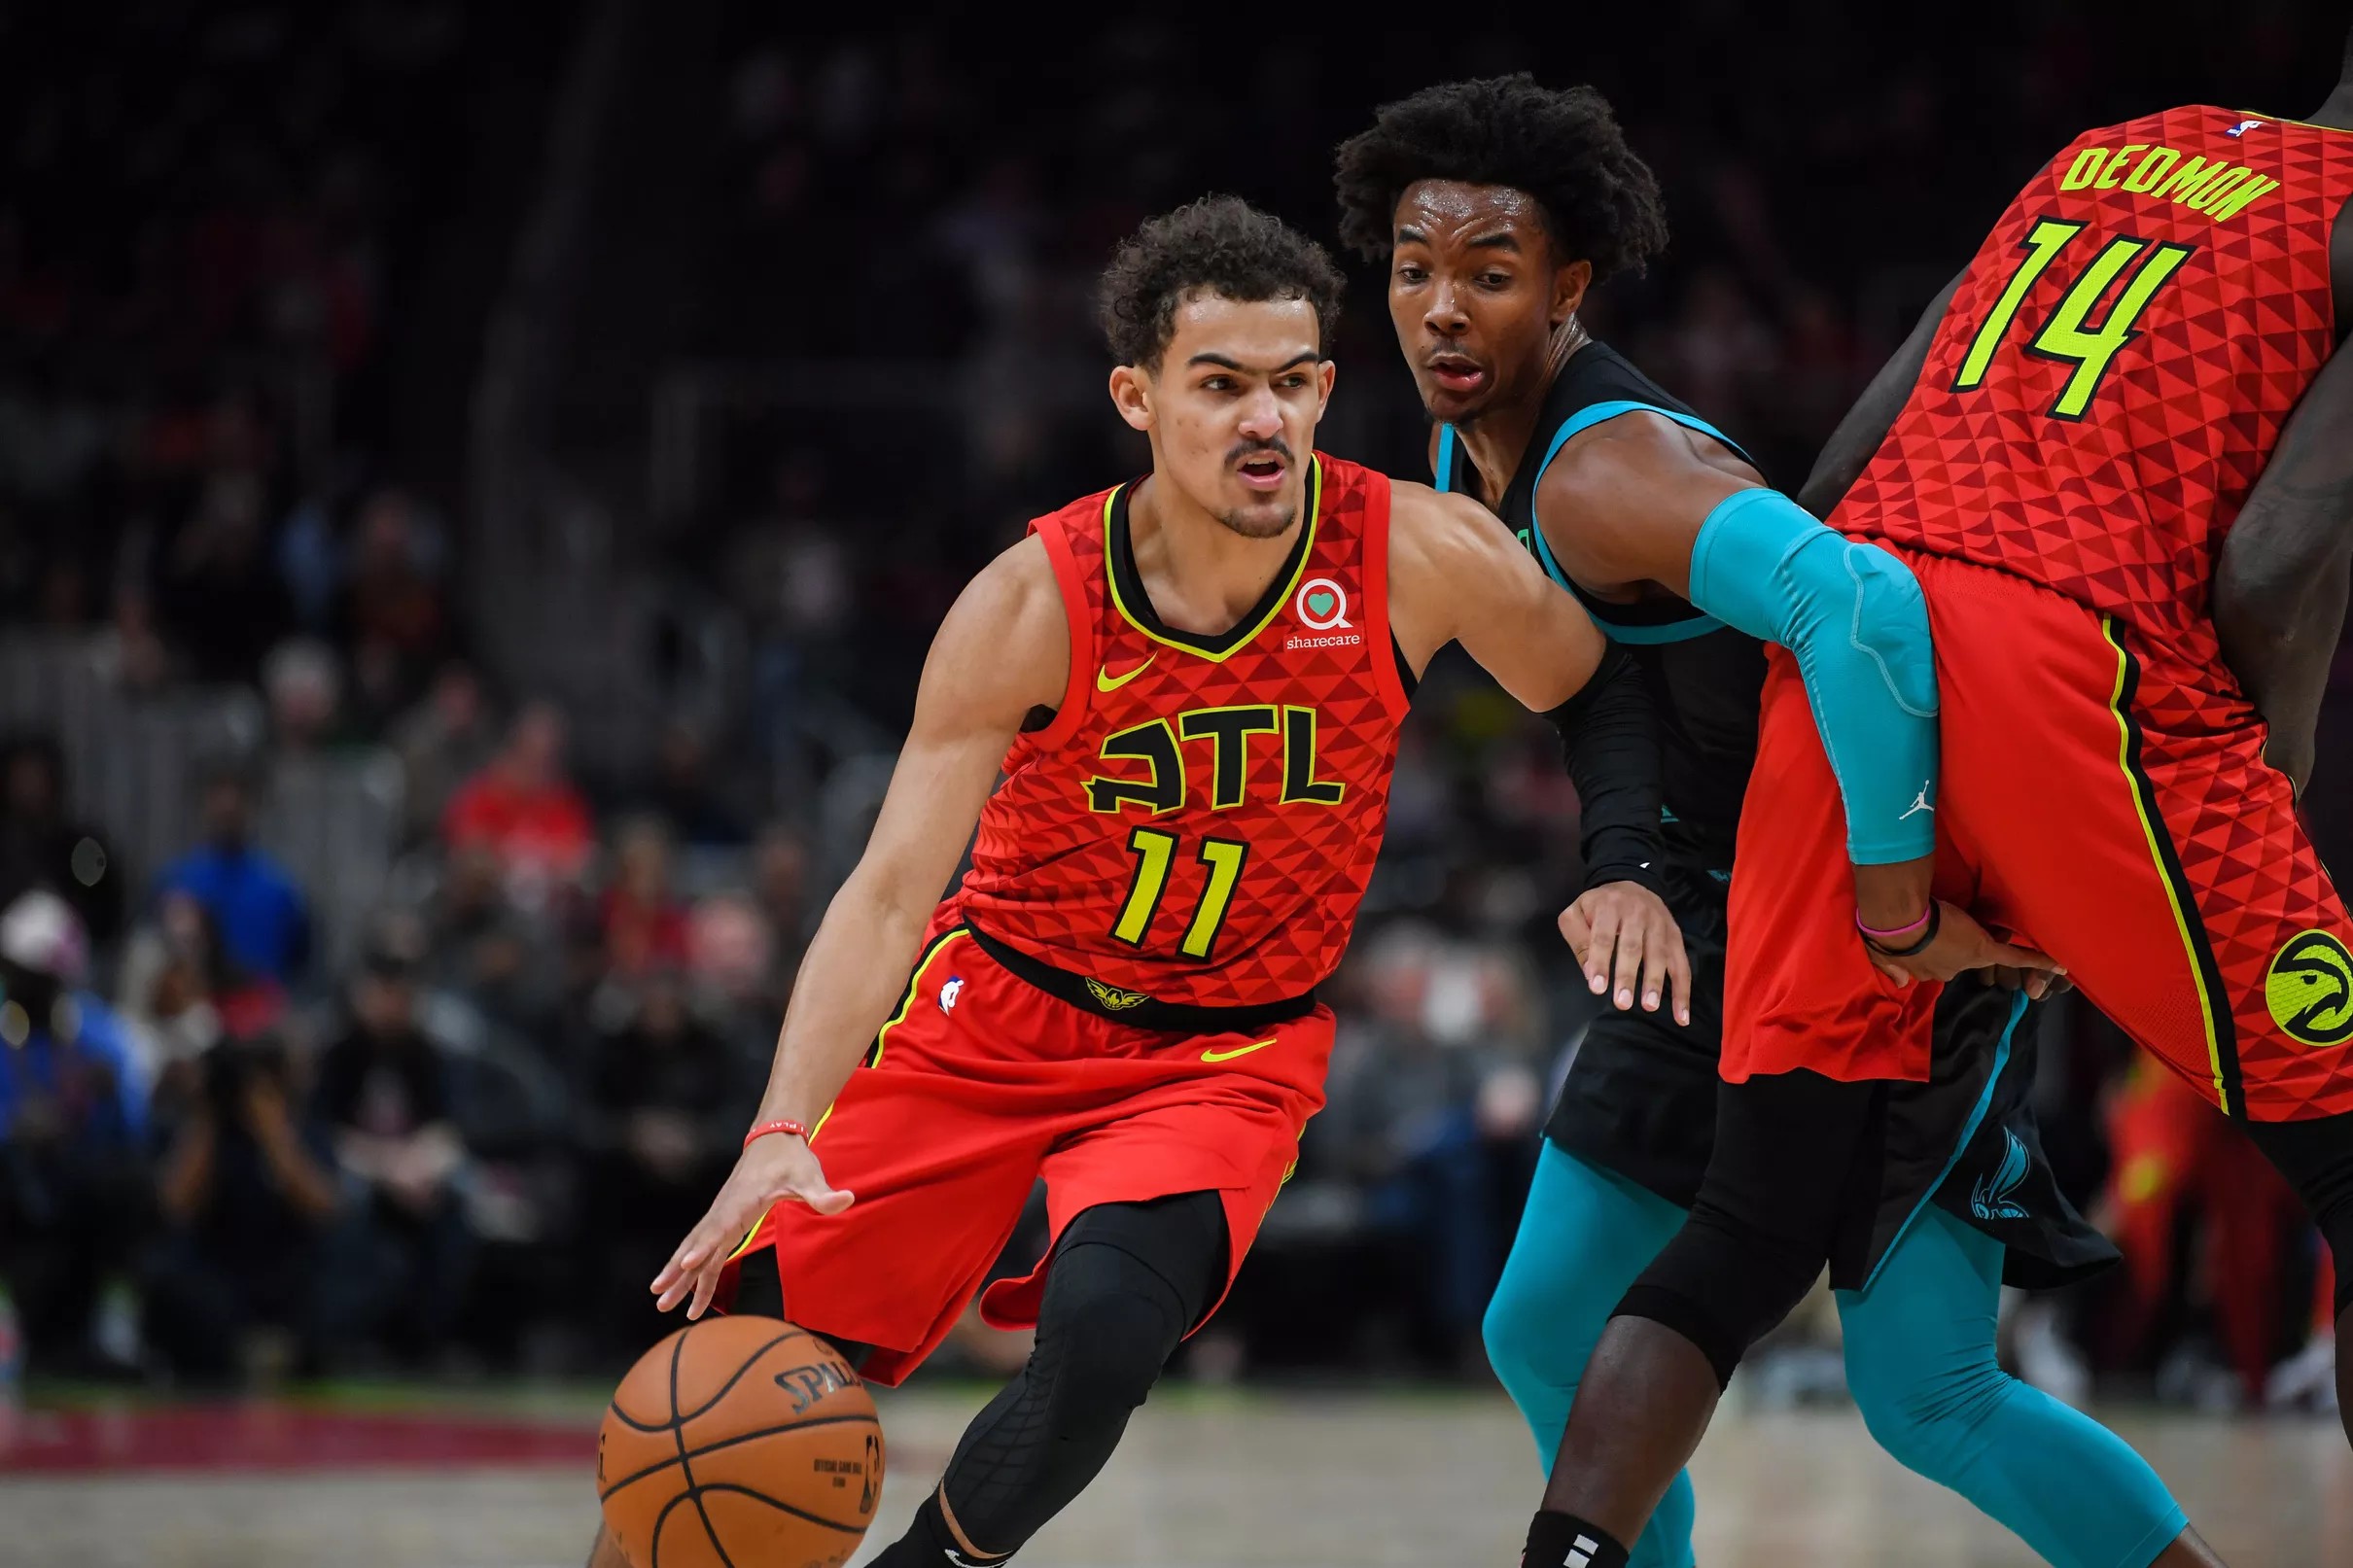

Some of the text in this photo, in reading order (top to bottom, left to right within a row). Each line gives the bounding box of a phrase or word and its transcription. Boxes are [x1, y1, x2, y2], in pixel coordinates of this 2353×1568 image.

[2060, 145, 2280, 222] DEDMON
[1949, 215, 2197, 423] 14
[1286, 635, 1360, 649] sharecare
[1080, 704, 1346, 815] ATL
[1108, 825, 1250, 963] 11
